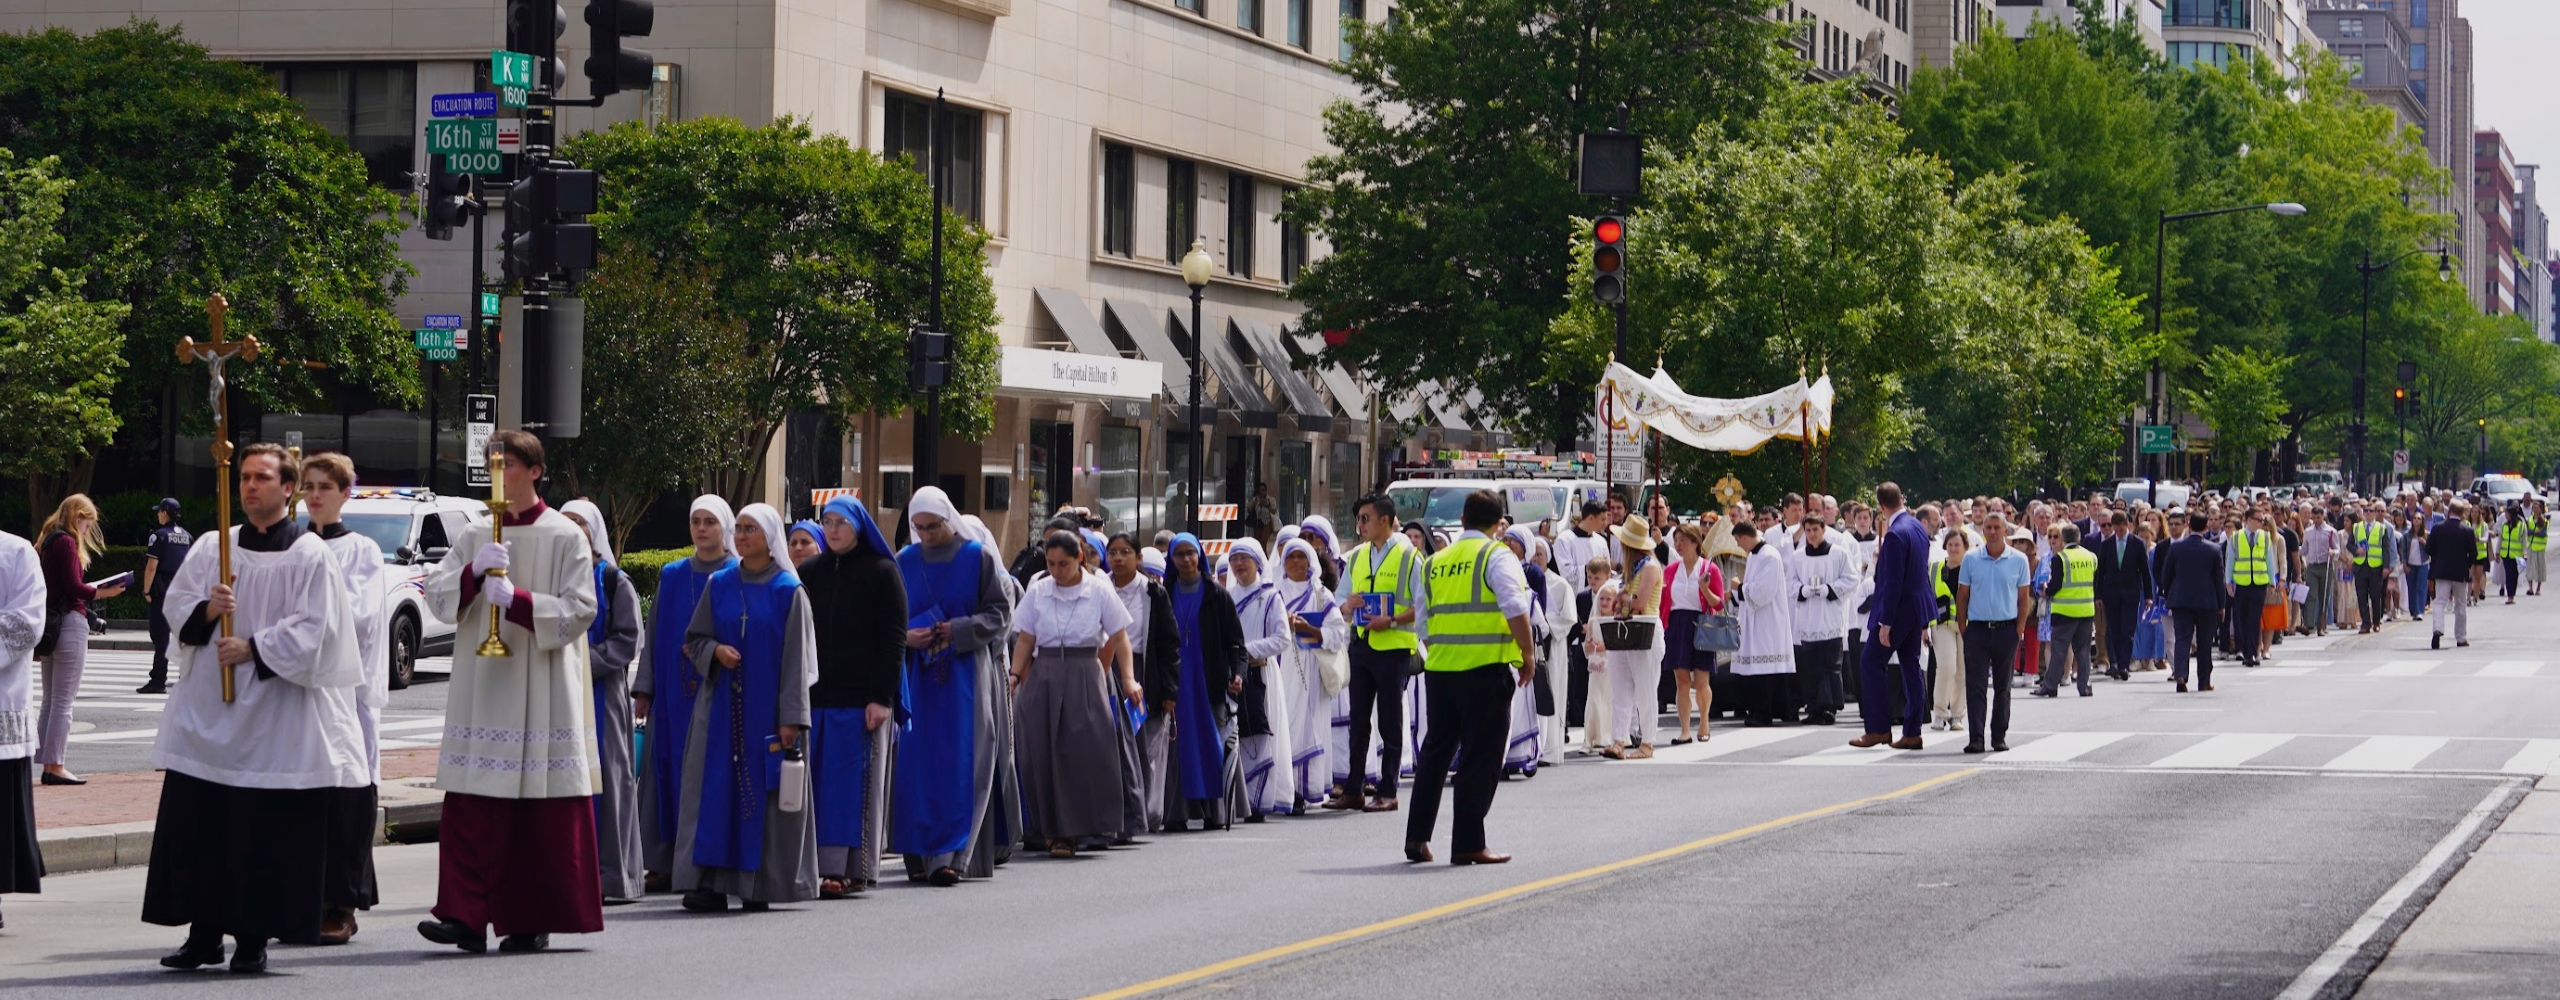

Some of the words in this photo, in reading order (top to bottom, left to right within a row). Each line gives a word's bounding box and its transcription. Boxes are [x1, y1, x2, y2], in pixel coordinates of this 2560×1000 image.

[503, 56, 513, 82] K
[521, 60, 529, 71] ST
[521, 72, 529, 83] NW
[503, 86, 526, 106] 1600
[434, 98, 472, 112] EVACUATION
[474, 97, 493, 110] ROUTE
[435, 124, 471, 148] 16th
[481, 123, 492, 136] ST
[479, 137, 493, 149] NW
[449, 153, 500, 171] 1000
[484, 296, 489, 311] K
[419, 332, 440, 347] 16th
[428, 348, 456, 359] 1000
[1053, 362, 1064, 379] The
[1065, 365, 1087, 387] Capital
[1088, 366, 1108, 383] Hilton
[476, 412, 486, 420] LANE
[1131, 402, 1140, 416] CVS
[473, 426, 489, 436] BUSES
[168, 536, 190, 544] POLICE
[1431, 561, 1472, 580] STAFF
